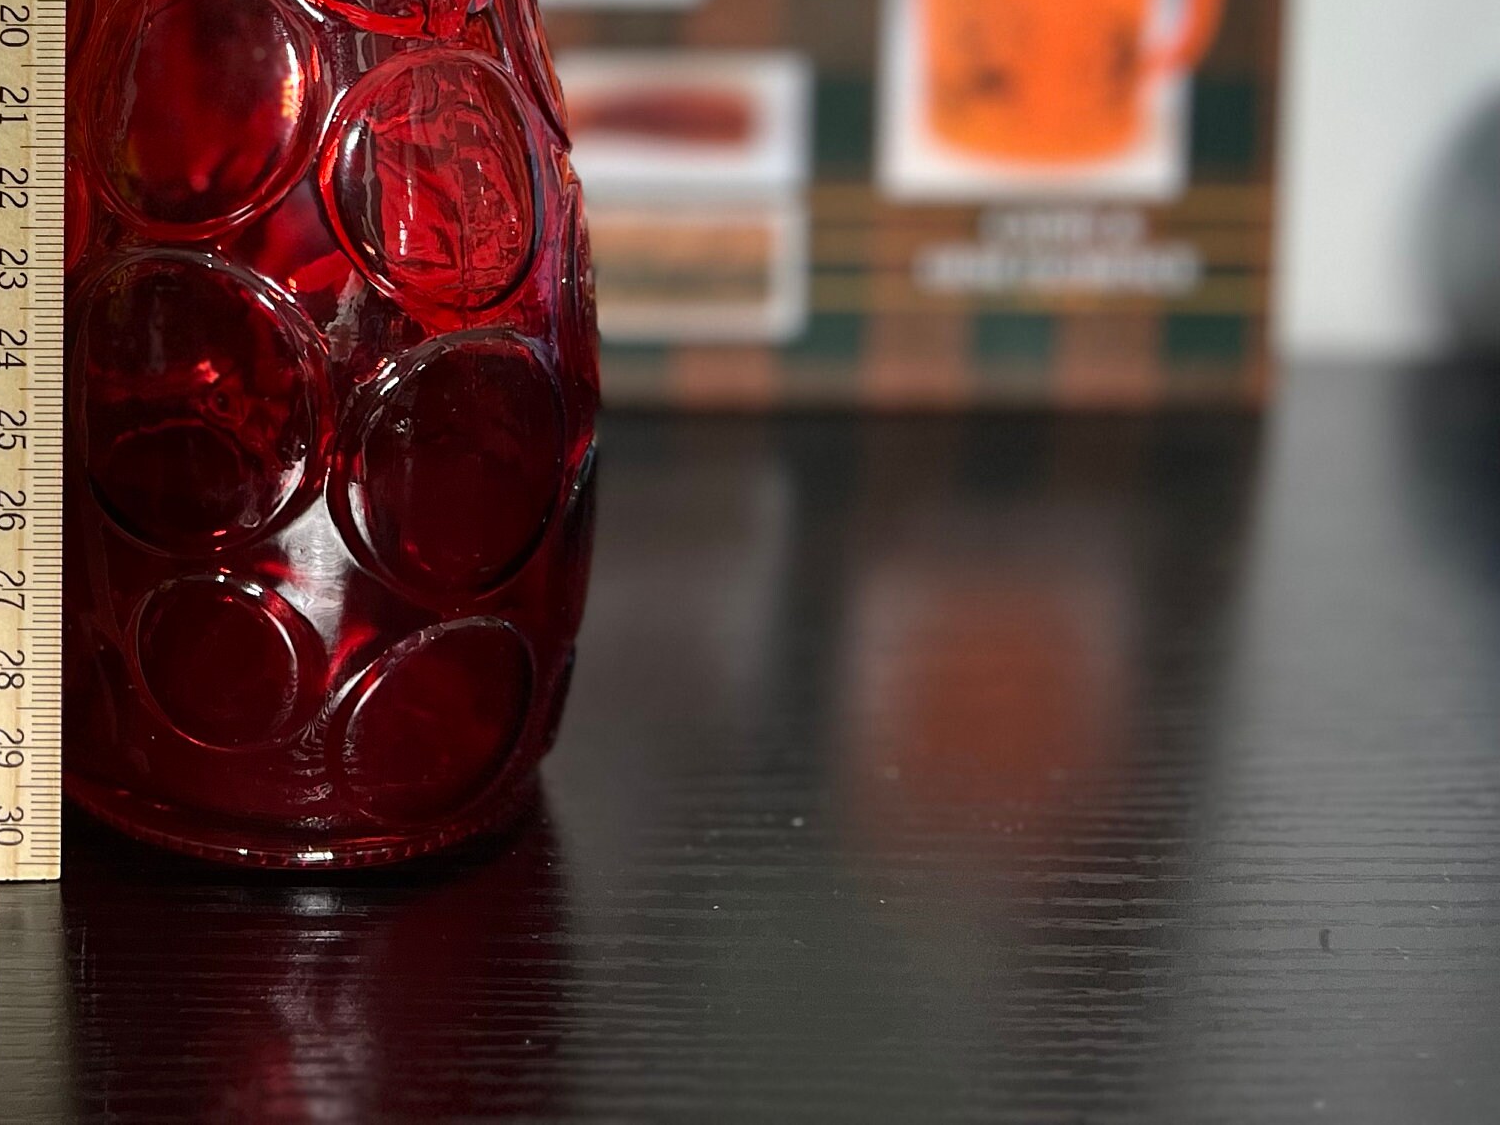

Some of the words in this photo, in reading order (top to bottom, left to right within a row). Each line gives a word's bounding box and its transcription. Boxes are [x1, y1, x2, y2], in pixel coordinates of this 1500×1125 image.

[0, 5, 30, 48] 20
[0, 86, 29, 124] 21
[0, 167, 28, 209] 22
